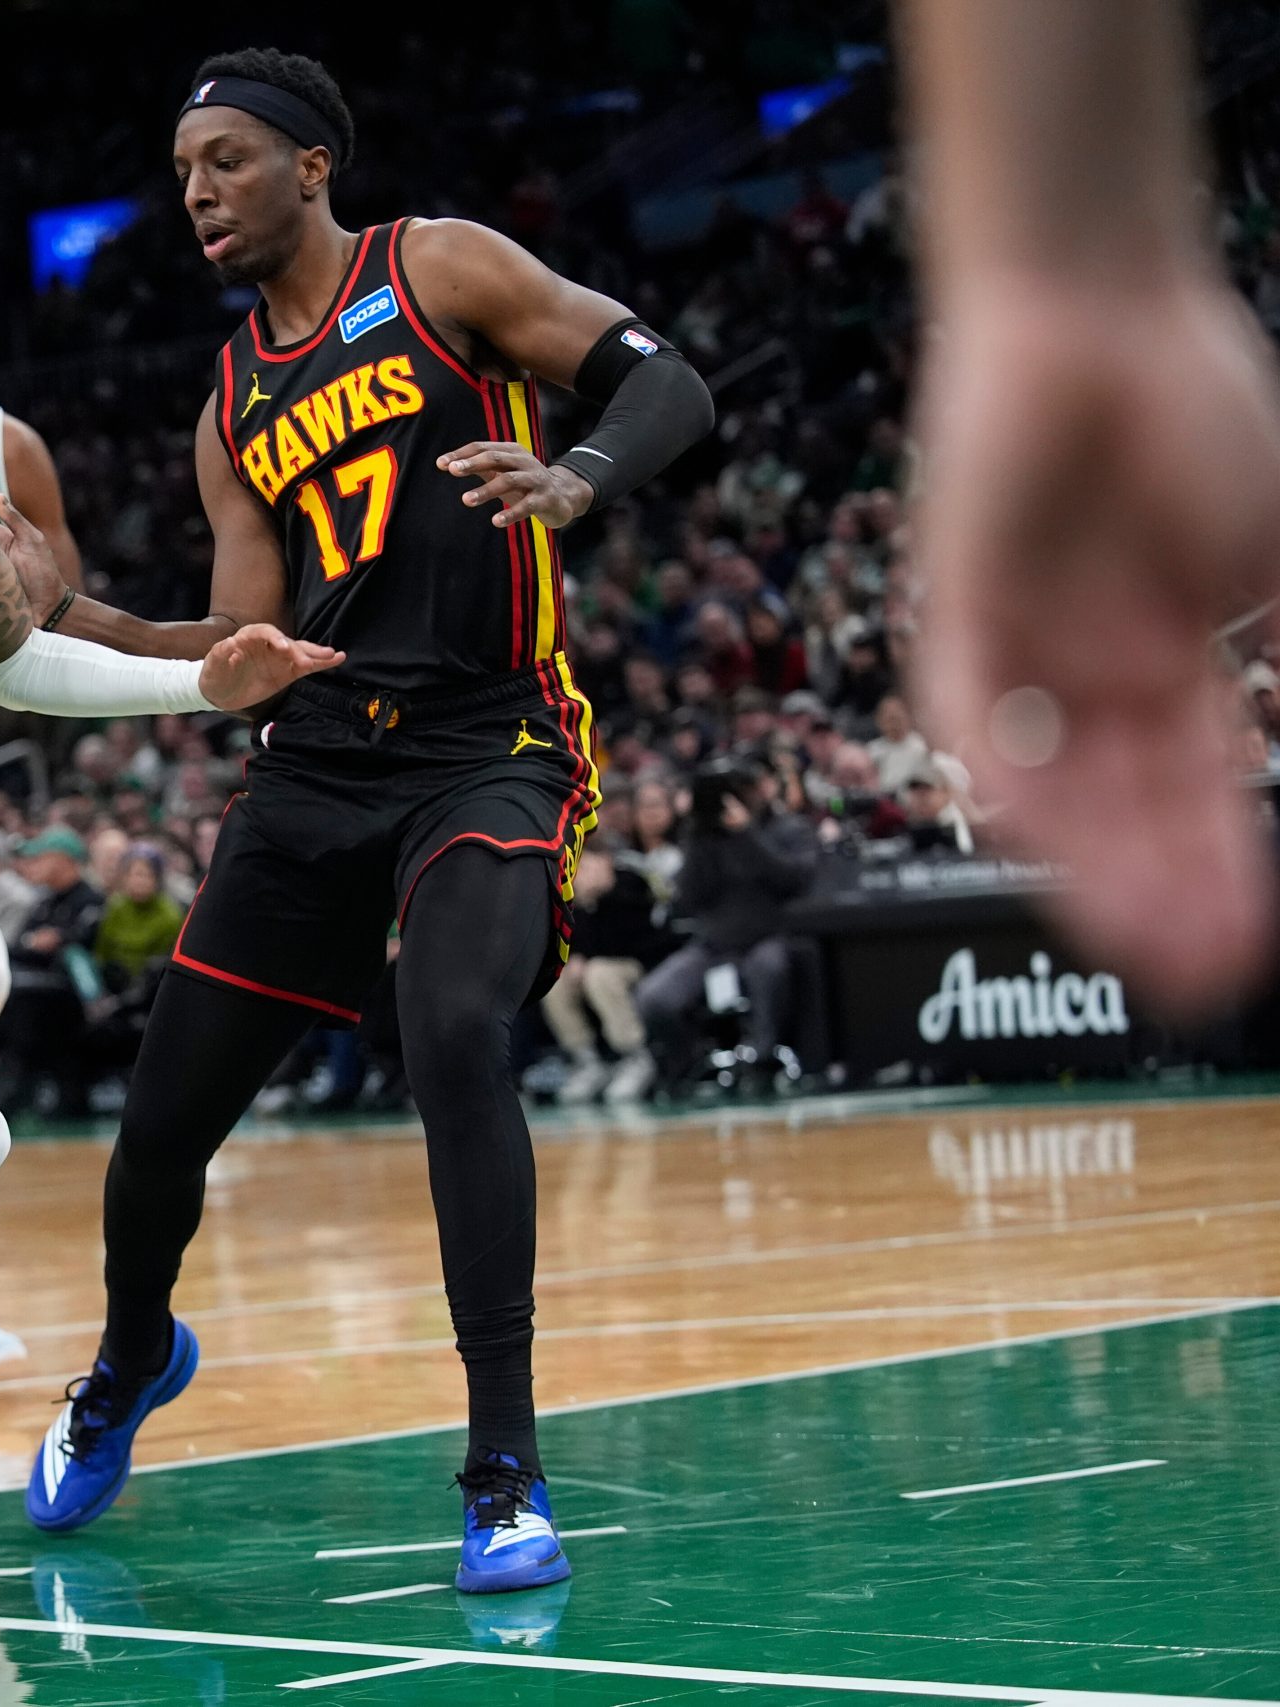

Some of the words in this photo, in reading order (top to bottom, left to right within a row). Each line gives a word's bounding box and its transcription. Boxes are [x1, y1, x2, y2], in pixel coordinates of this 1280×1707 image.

[345, 297, 390, 335] paze
[241, 354, 425, 507] HAWKS
[294, 444, 399, 582] 17
[918, 947, 1129, 1043] Amica
